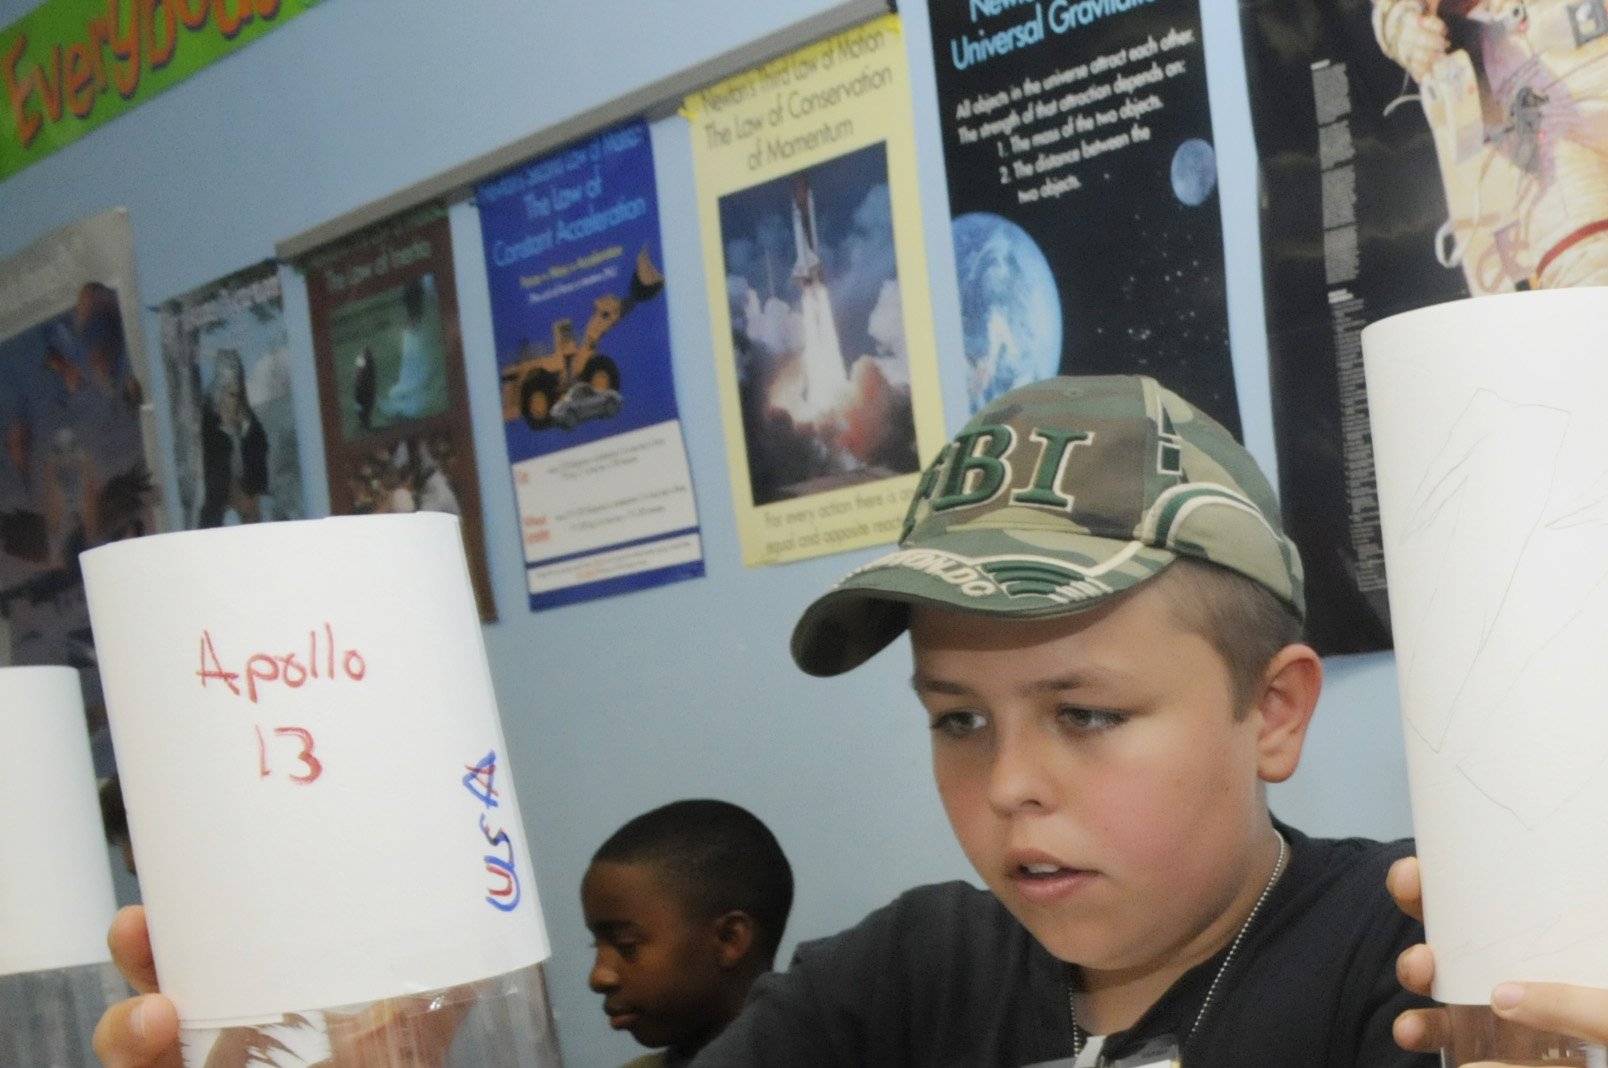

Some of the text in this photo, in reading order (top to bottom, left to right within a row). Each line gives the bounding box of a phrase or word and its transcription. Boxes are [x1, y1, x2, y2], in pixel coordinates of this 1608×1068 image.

[837, 30, 885, 63] Motion
[951, 2, 1045, 70] Universal
[704, 66, 894, 150] The Law of Conservation
[956, 99, 972, 121] All
[972, 92, 1010, 116] objects
[1010, 85, 1022, 101] in
[1023, 77, 1042, 97] the
[1042, 65, 1089, 91] universe
[1090, 49, 1128, 75] attract
[1128, 35, 1159, 62] each
[958, 125, 979, 145] The
[979, 109, 1021, 136] strength
[1022, 101, 1034, 125] of
[1035, 99, 1058, 121] that
[1059, 83, 1112, 112] attraction
[1113, 61, 1164, 94] depends
[748, 118, 854, 171] of Momentum
[1010, 134, 1031, 154] The
[1031, 128, 1061, 148] mass
[1061, 115, 1075, 138] of
[1075, 113, 1095, 133] the
[1095, 109, 1118, 127] two
[1013, 159, 1034, 180] The
[1035, 148, 1081, 173] distance
[1081, 133, 1130, 159] between
[1130, 122, 1151, 143] the
[556, 196, 647, 244] Acceleration
[1017, 188, 1039, 205] two
[195, 622, 367, 704] Apollo
[253, 724, 324, 786] 13
[462, 749, 521, 913] USA
